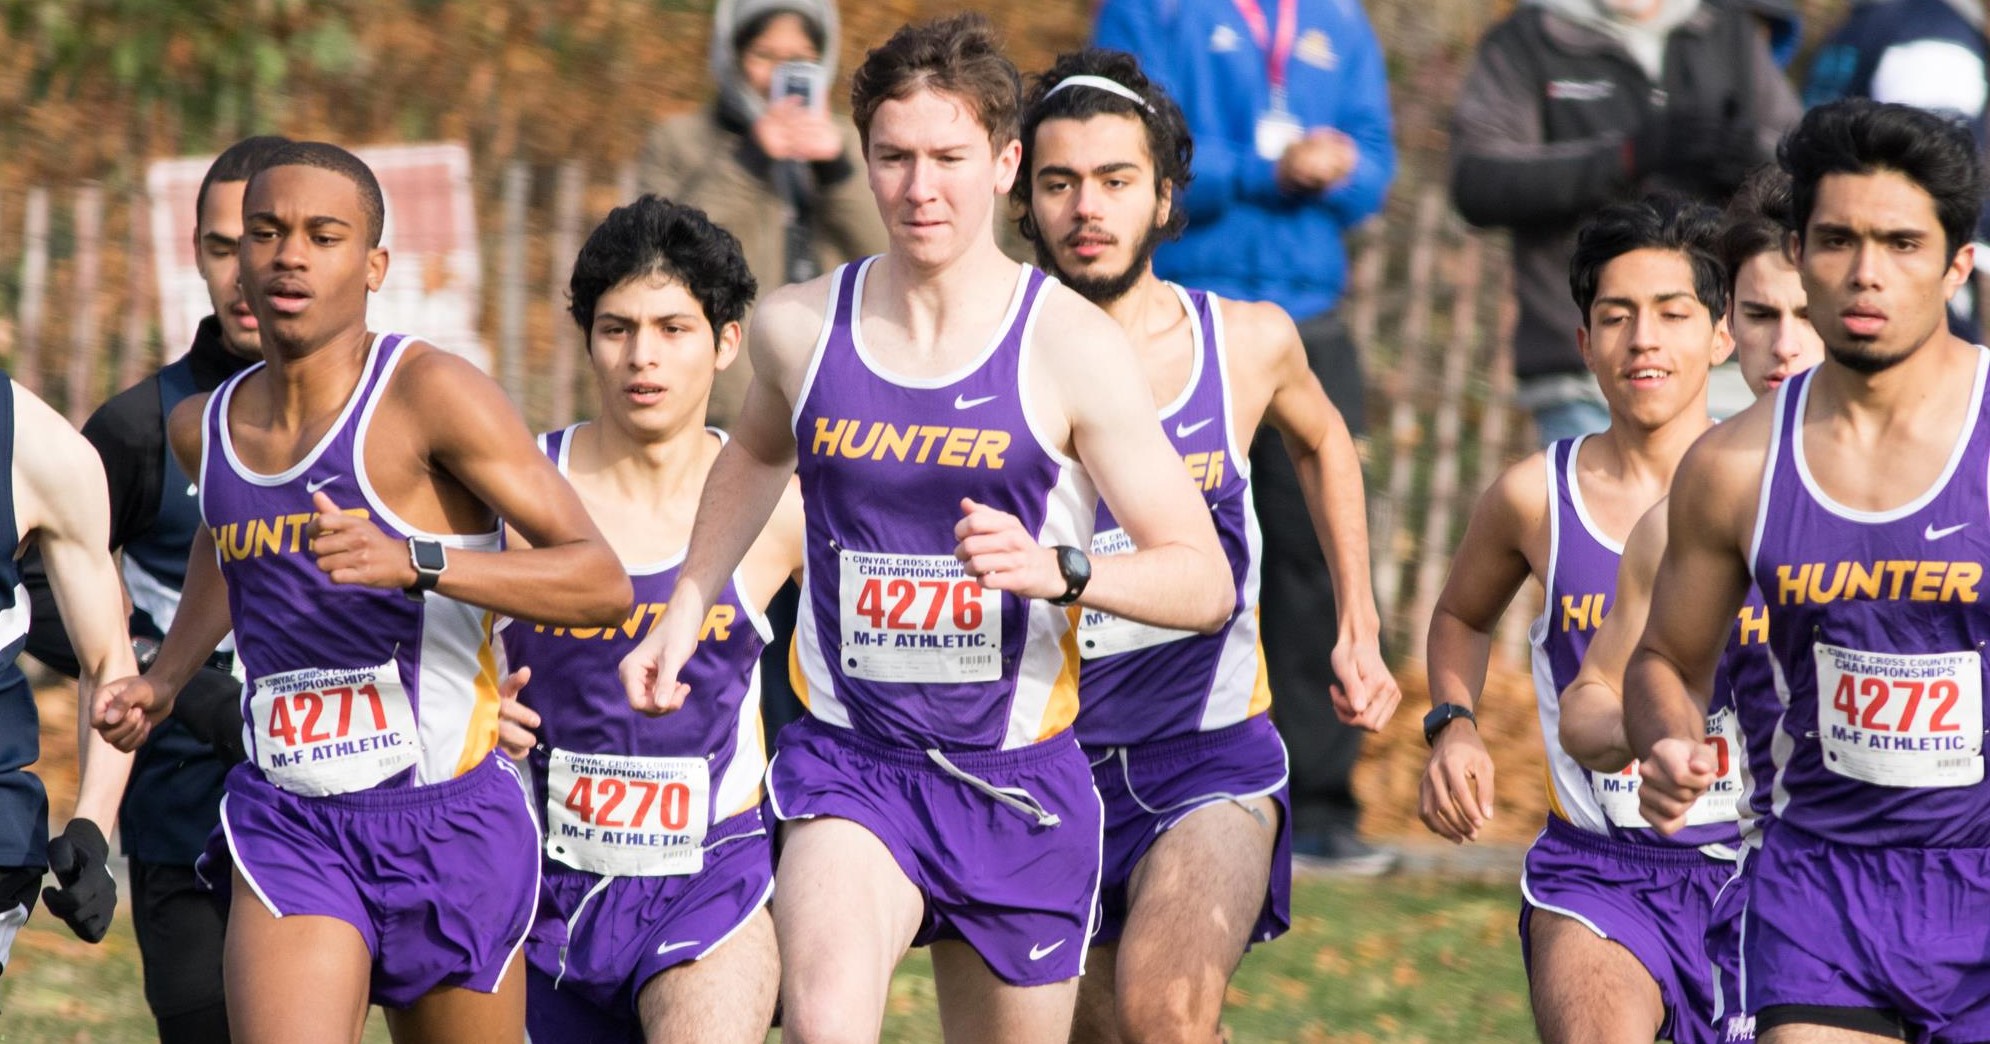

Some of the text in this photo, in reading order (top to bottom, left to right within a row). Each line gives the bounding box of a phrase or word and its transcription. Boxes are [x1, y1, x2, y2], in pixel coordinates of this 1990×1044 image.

[812, 417, 1012, 469] HUNTER
[211, 508, 370, 563] HUNT
[853, 555, 893, 566] CUNYAC
[896, 558, 931, 567] CROSS
[860, 565, 965, 578] CHAMPIONSHI
[1776, 560, 1983, 605] HUNTER
[856, 578, 983, 631] 4276
[854, 631, 986, 648] M-F ATHLETIC
[1834, 658, 1956, 678] CHAMPIONSHIPS
[1869, 656, 1906, 667] CROSS
[1909, 657, 1963, 667] COUNTRY
[1833, 672, 1960, 733] 4272
[269, 683, 387, 748] 4271
[271, 732, 402, 768] M-F ATHLETIC
[1832, 724, 1965, 751] M-F ATHLETIC
[565, 754, 605, 769] CUNYAC
[608, 761, 644, 770] CROSS
[571, 764, 688, 780] CHAMPIONSHIPS
[1603, 778, 1638, 793] M-F
[565, 775, 690, 831] 4270
[561, 823, 691, 847] M-F ATHLETIC
